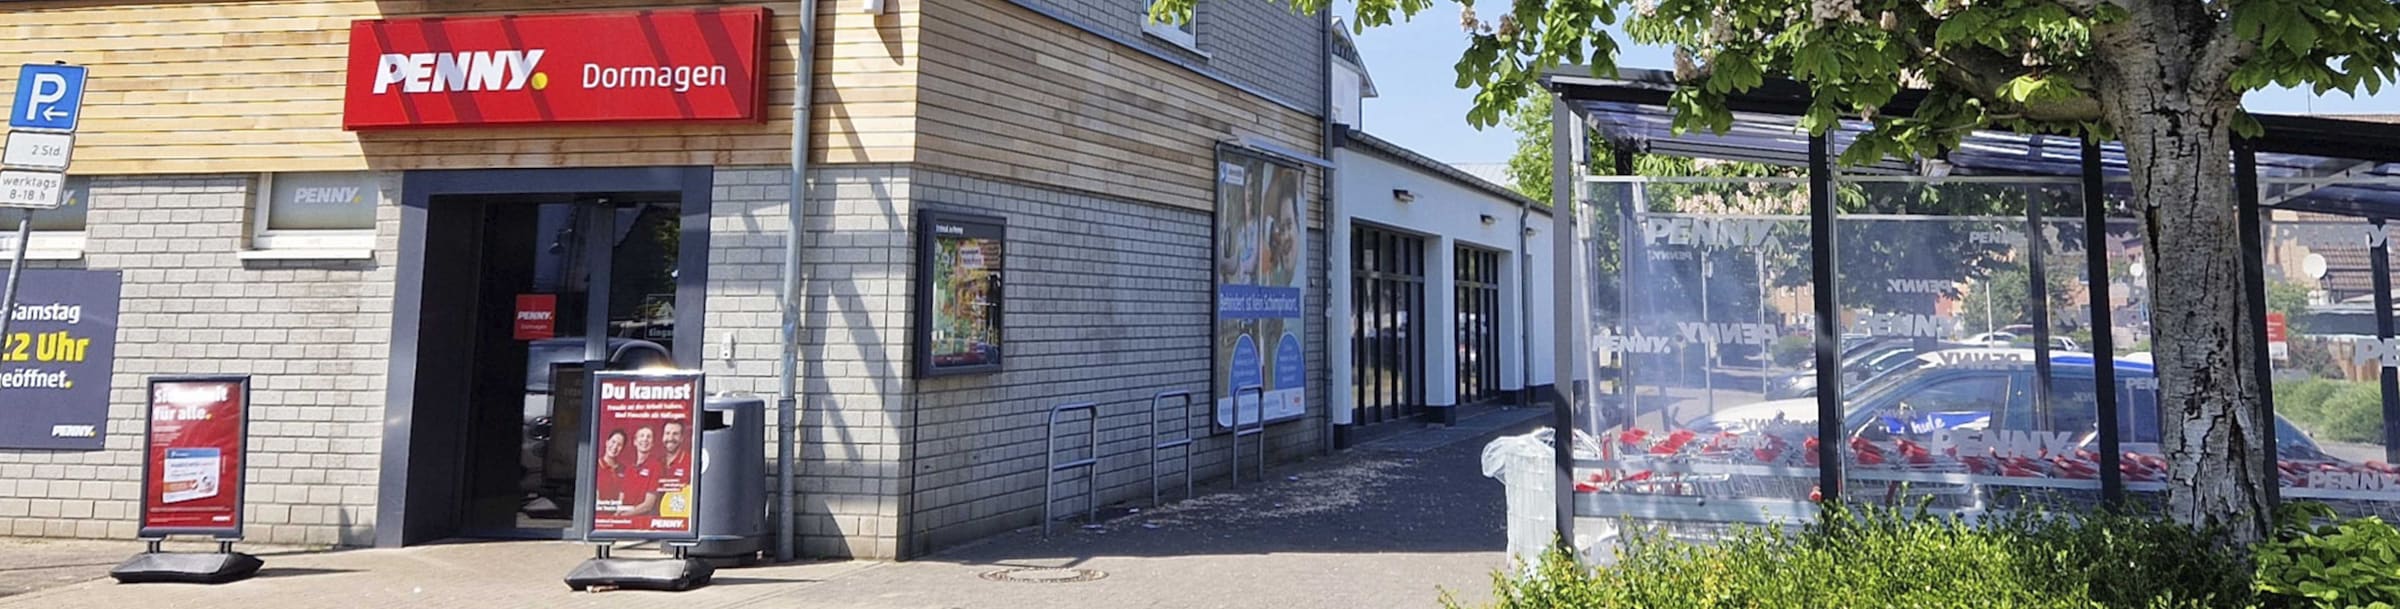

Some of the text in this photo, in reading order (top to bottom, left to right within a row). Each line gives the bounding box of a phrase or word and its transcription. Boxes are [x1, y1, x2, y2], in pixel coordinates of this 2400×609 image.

[372, 49, 726, 94] PENNY. Dormagen
[26, 73, 67, 121] P
[31, 144, 38, 155] 2
[2, 175, 57, 190] werktags
[9, 188, 46, 200] 8-18 h
[36, 331, 90, 361] Uhr
[0, 369, 72, 388] eöffnet.
[602, 382, 690, 400] Du kannst
[154, 405, 212, 420] für alle.
